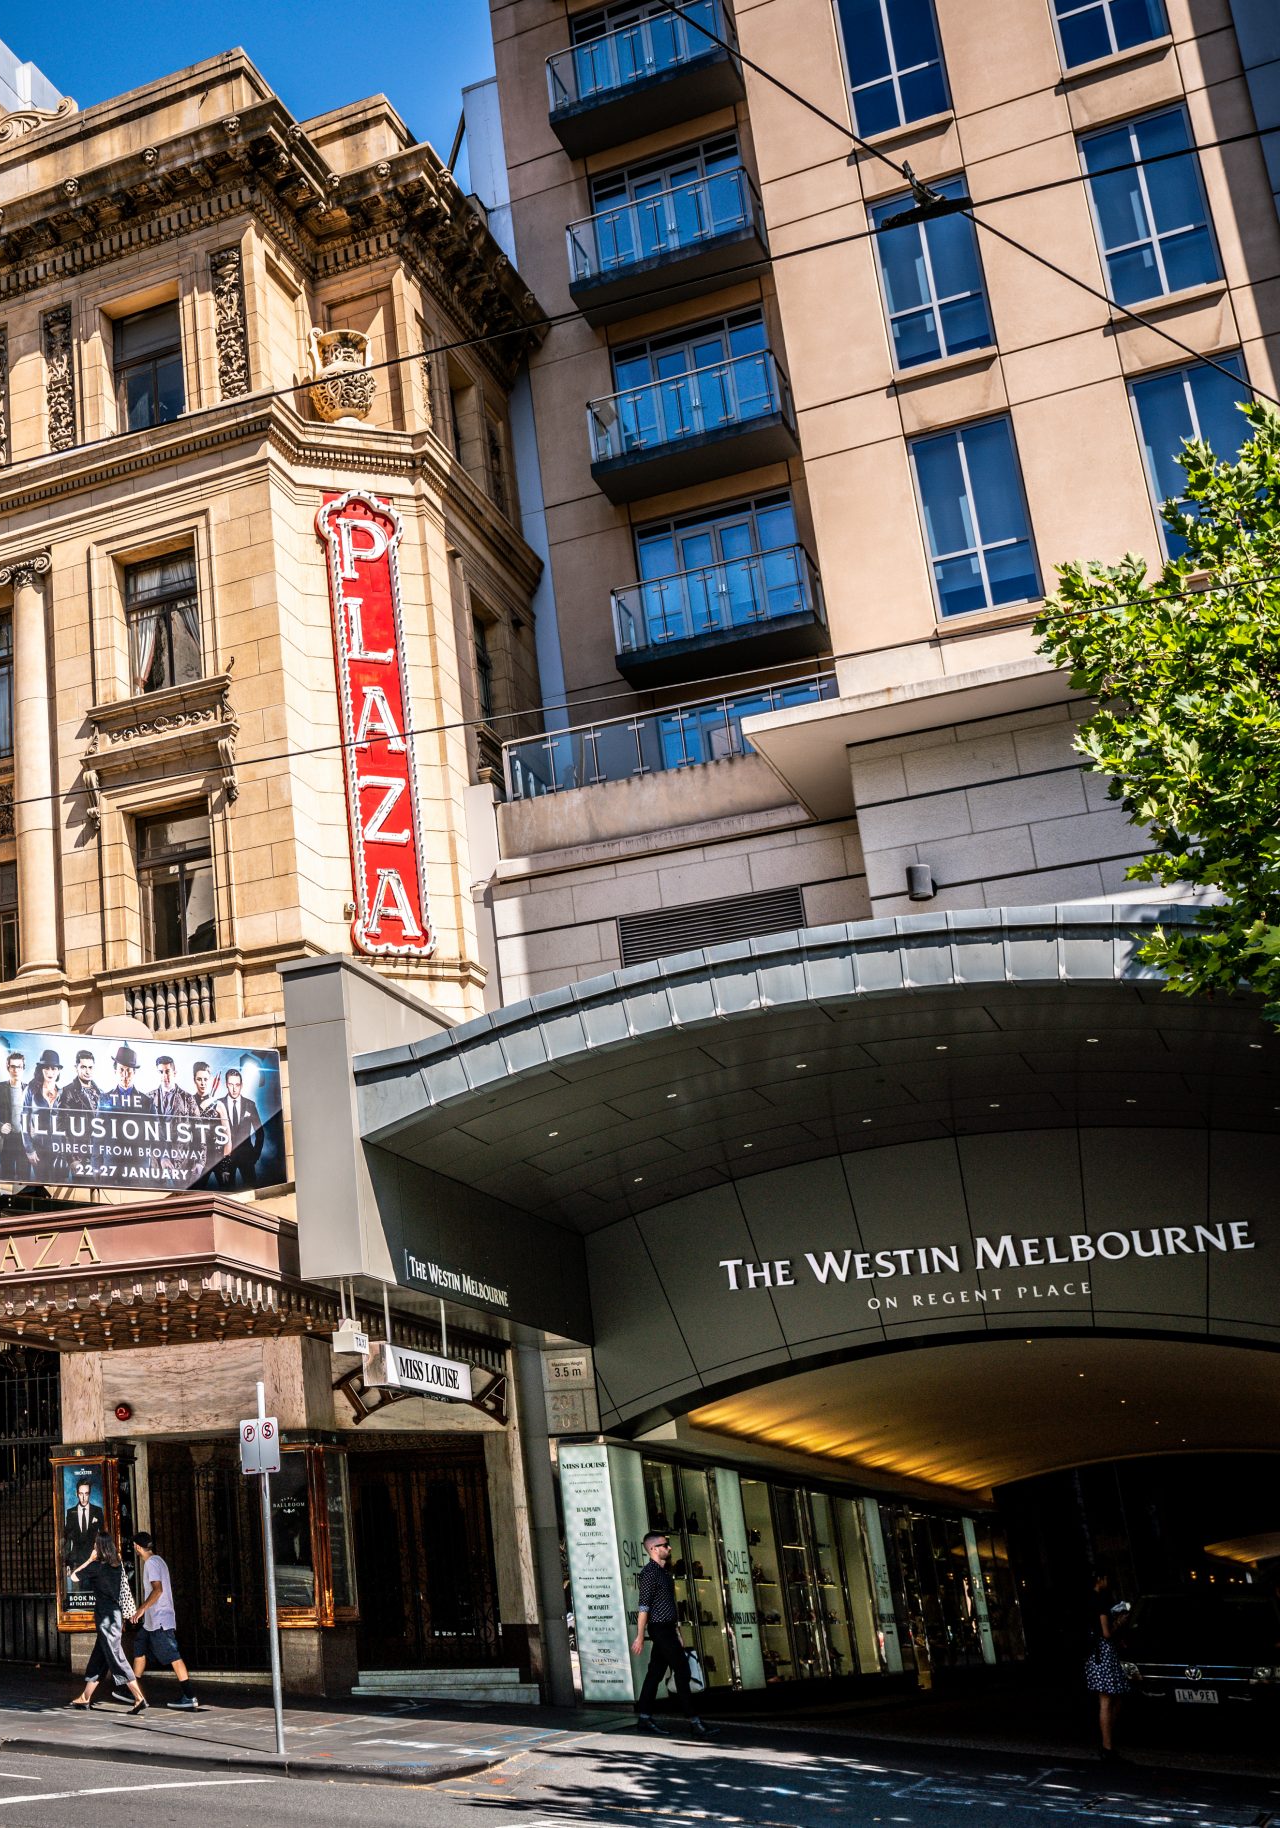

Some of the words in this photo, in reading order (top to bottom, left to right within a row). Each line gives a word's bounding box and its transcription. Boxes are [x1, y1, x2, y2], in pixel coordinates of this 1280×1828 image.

[335, 516, 423, 939] PLAZA
[110, 1094, 142, 1108] THE
[21, 1113, 230, 1145] ILLUSIONISTS
[52, 1142, 93, 1154] DIRECT
[99, 1145, 133, 1157] FROM
[138, 1147, 204, 1161] BROADWAY
[76, 1164, 117, 1177] 22-27
[122, 1166, 189, 1181] JANUARY
[866, 1296, 898, 1311] ON
[912, 1287, 1003, 1308] REGENT
[1017, 1281, 1093, 1299] PLACE
[399, 1356, 424, 1382] MISS
[424, 1362, 460, 1390] LOUISE
[554, 1367, 569, 1378] 3.5
[572, 1368, 582, 1377] m
[726, 1549, 749, 1575] SALE
